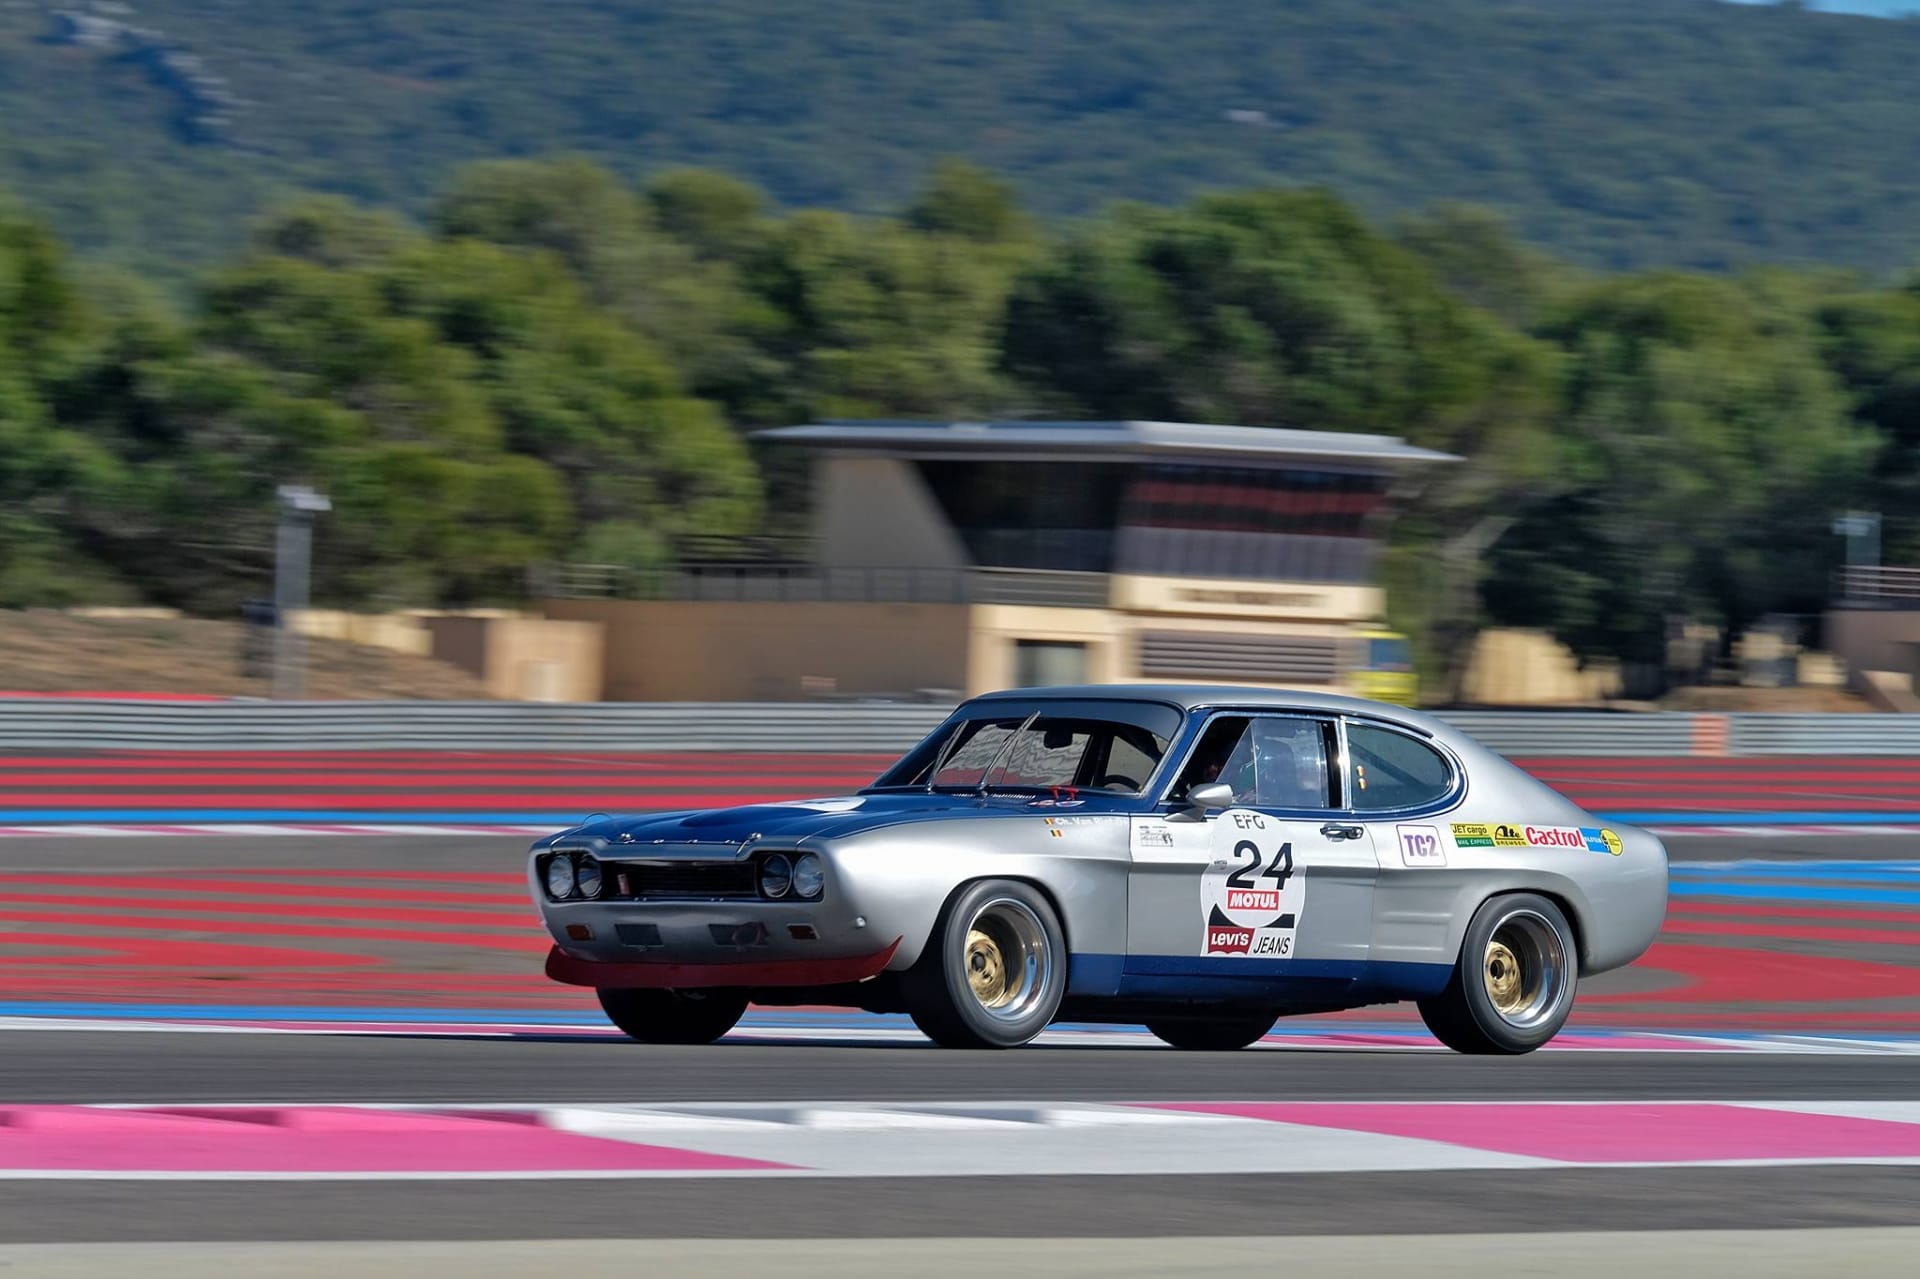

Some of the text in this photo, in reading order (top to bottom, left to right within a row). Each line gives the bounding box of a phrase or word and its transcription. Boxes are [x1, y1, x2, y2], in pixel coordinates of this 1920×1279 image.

[1233, 814, 1265, 829] EFG
[1453, 825, 1487, 836] JET cargo
[1404, 835, 1439, 857] TC2
[1525, 827, 1586, 848] Castrol
[1226, 840, 1294, 890] 24
[1230, 892, 1277, 909] MOTUL
[1253, 937, 1291, 955] JEANS
